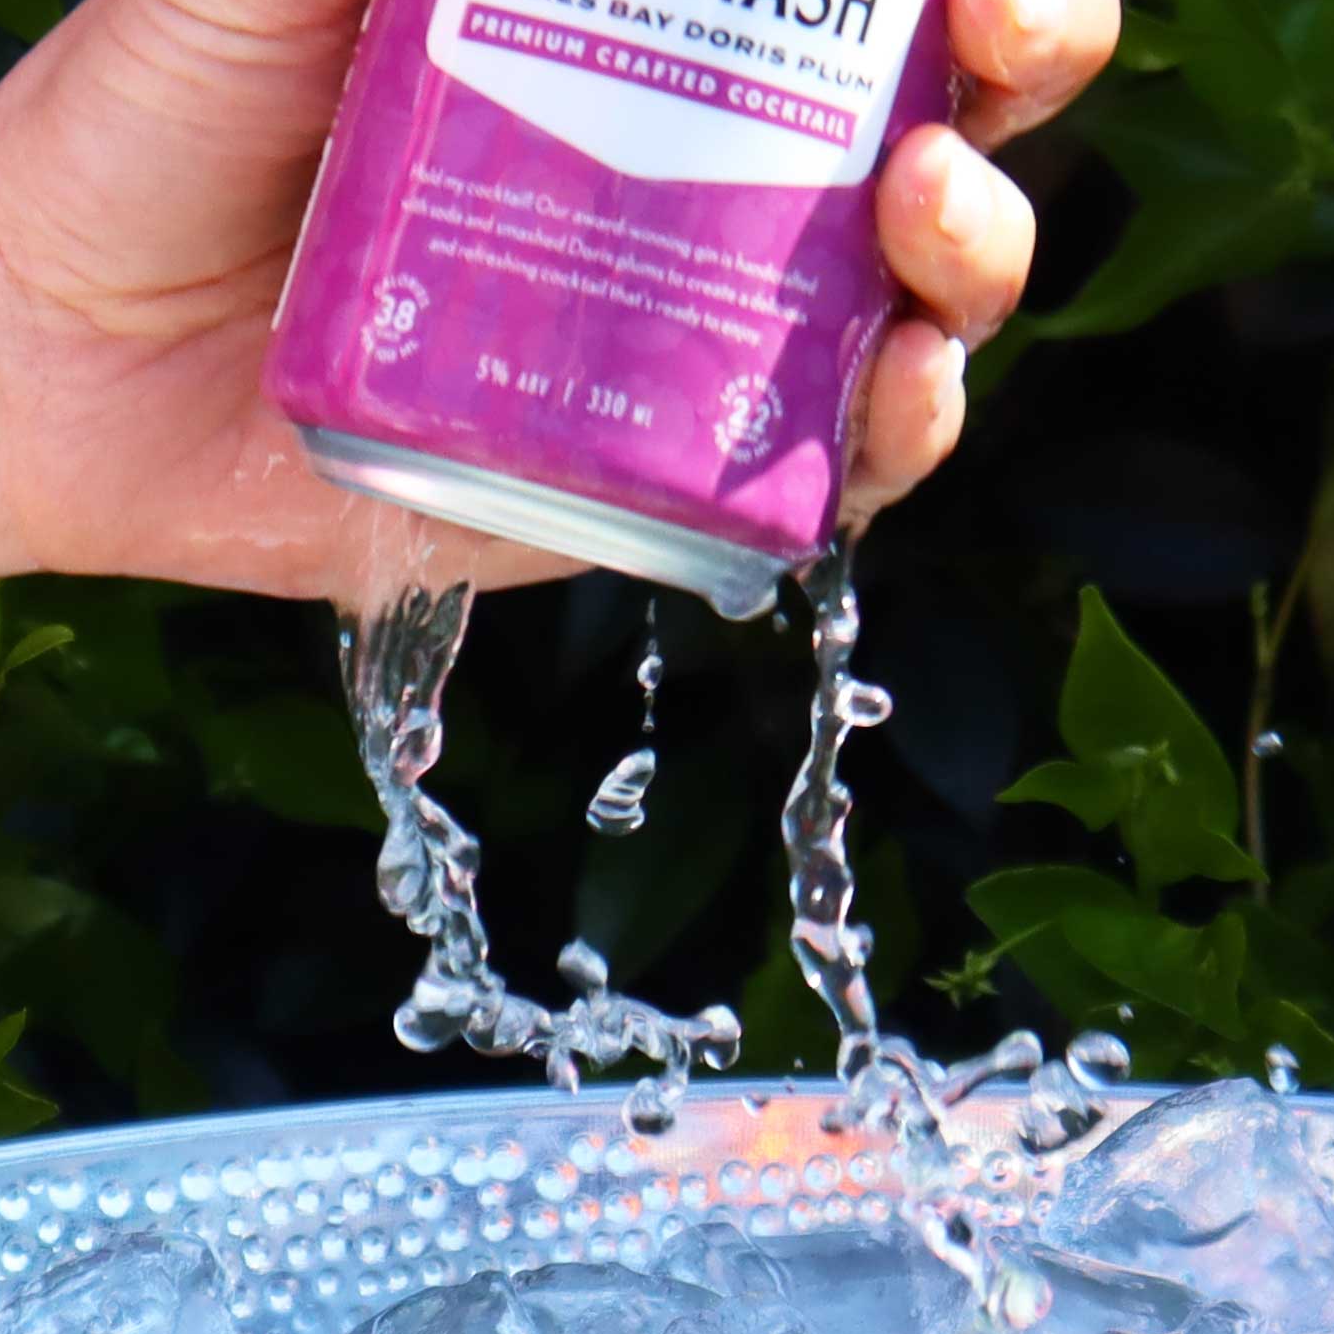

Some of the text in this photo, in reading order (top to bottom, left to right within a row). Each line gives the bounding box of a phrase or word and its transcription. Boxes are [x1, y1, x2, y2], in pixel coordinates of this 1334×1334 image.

[469, 11, 848, 141] PREMIUM CRAFTED COCKTAIL
[684, 20, 786, 66] DORIS
[797, 54, 874, 93] PLUM
[535, 194, 569, 218] Our
[569, 235, 614, 265] Doris
[374, 295, 417, 333] 38
[475, 353, 510, 387] 5%
[586, 384, 628, 421] 330
